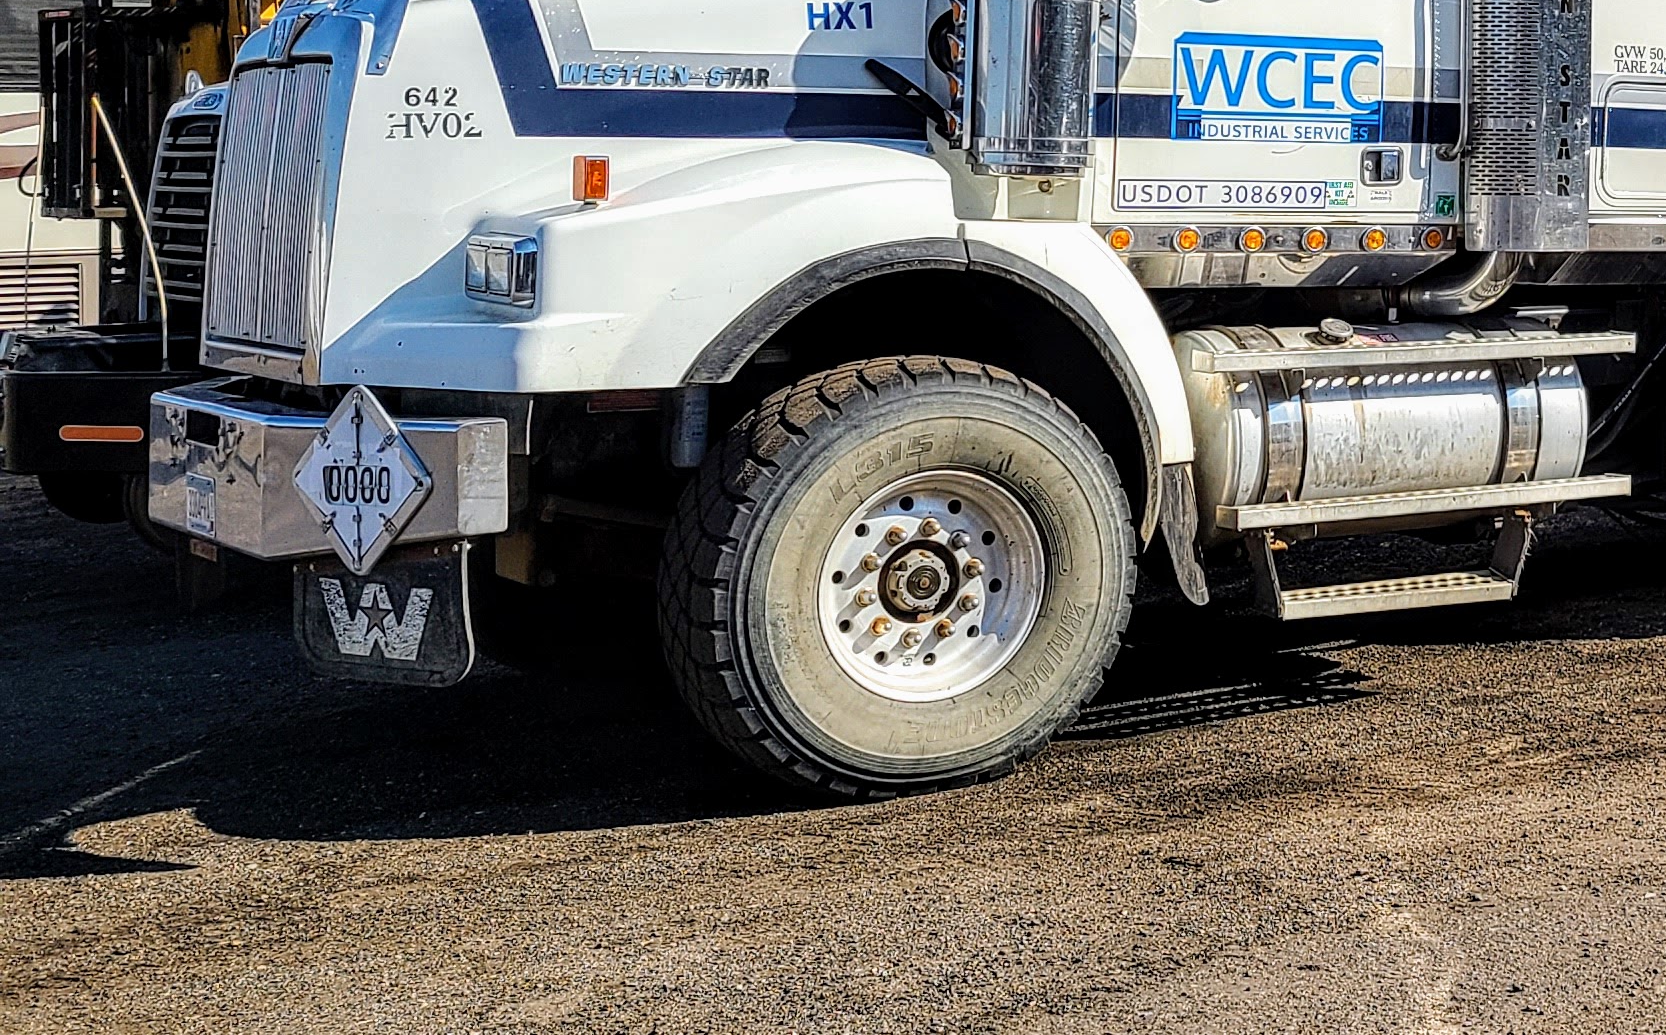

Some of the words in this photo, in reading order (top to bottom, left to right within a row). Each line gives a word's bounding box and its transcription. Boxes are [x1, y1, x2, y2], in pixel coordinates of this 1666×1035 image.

[806, 1, 874, 31] HX1
[1614, 44, 1647, 59] GVW
[561, 63, 690, 86] WESTERN
[706, 65, 770, 89] STAR
[1613, 59, 1648, 73] TARE
[1180, 46, 1380, 112] WCEC
[404, 87, 458, 107] 642
[1188, 122, 1289, 139] INDUSTRIAL
[1294, 125, 1369, 141] SERVICES
[1122, 184, 1209, 204] USDOT
[1221, 184, 1323, 205] 3086909
[328, 465, 391, 505] 0000
[318, 576, 434, 661] W
